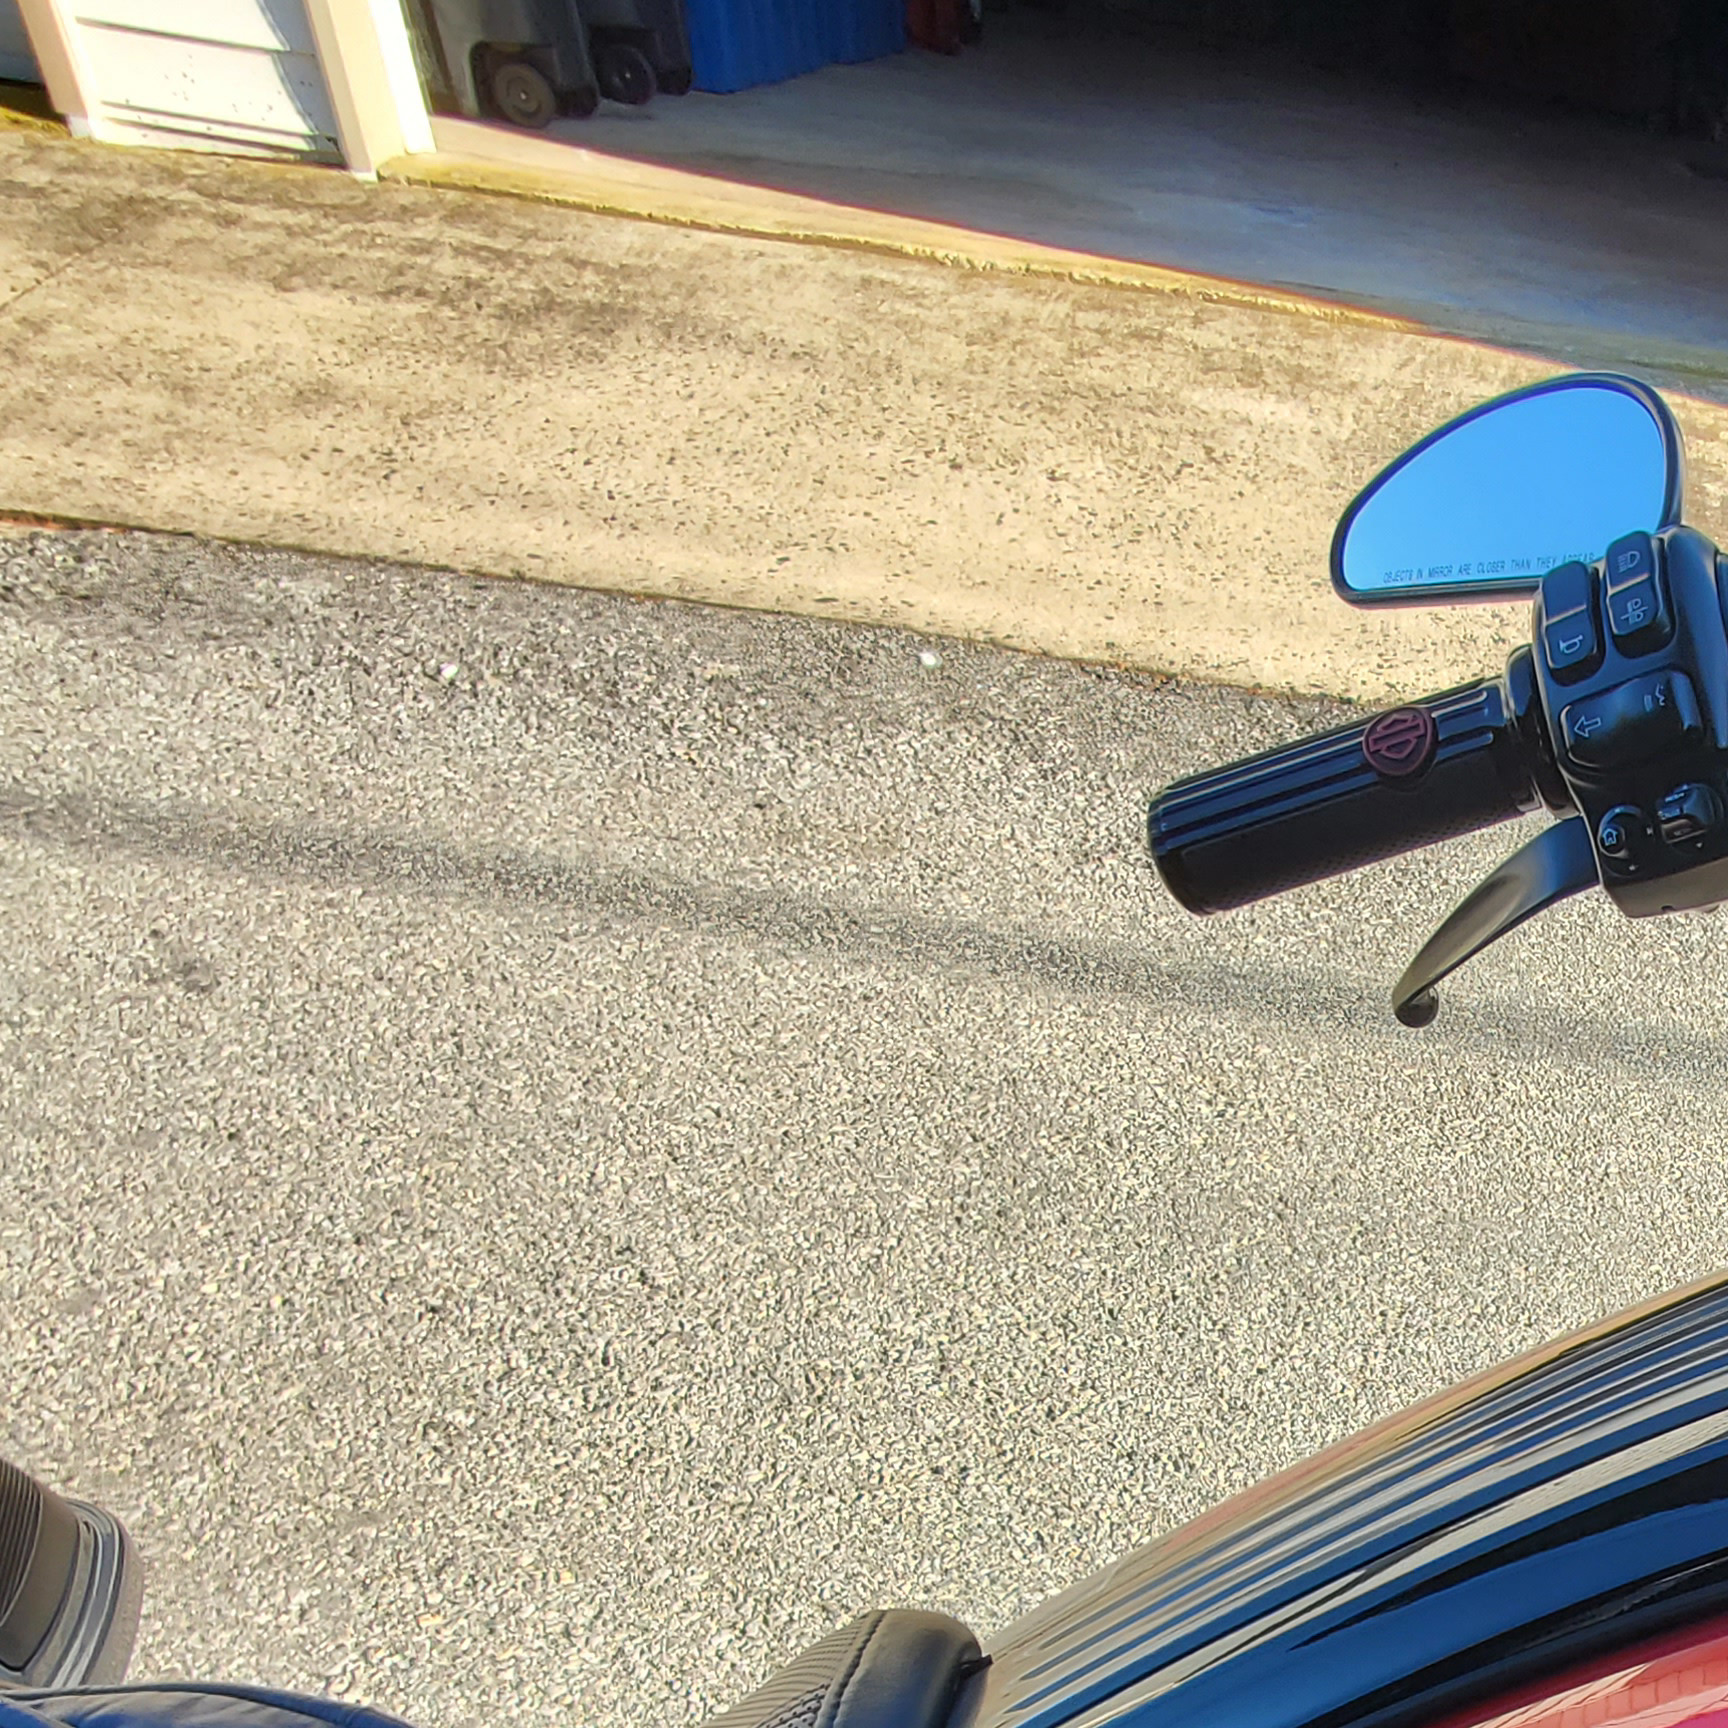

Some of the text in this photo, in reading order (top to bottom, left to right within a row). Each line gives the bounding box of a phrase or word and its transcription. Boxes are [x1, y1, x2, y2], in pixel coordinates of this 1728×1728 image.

[1383, 569, 1413, 583] OBJECTS
[1416, 568, 1424, 580] IN
[1428, 565, 1453, 579] MIRROR
[1457, 563, 1472, 575] ARE
[1477, 561, 1505, 574] CLOSER
[1511, 558, 1531, 570] THAN
[1536, 556, 1556, 568] THEY
